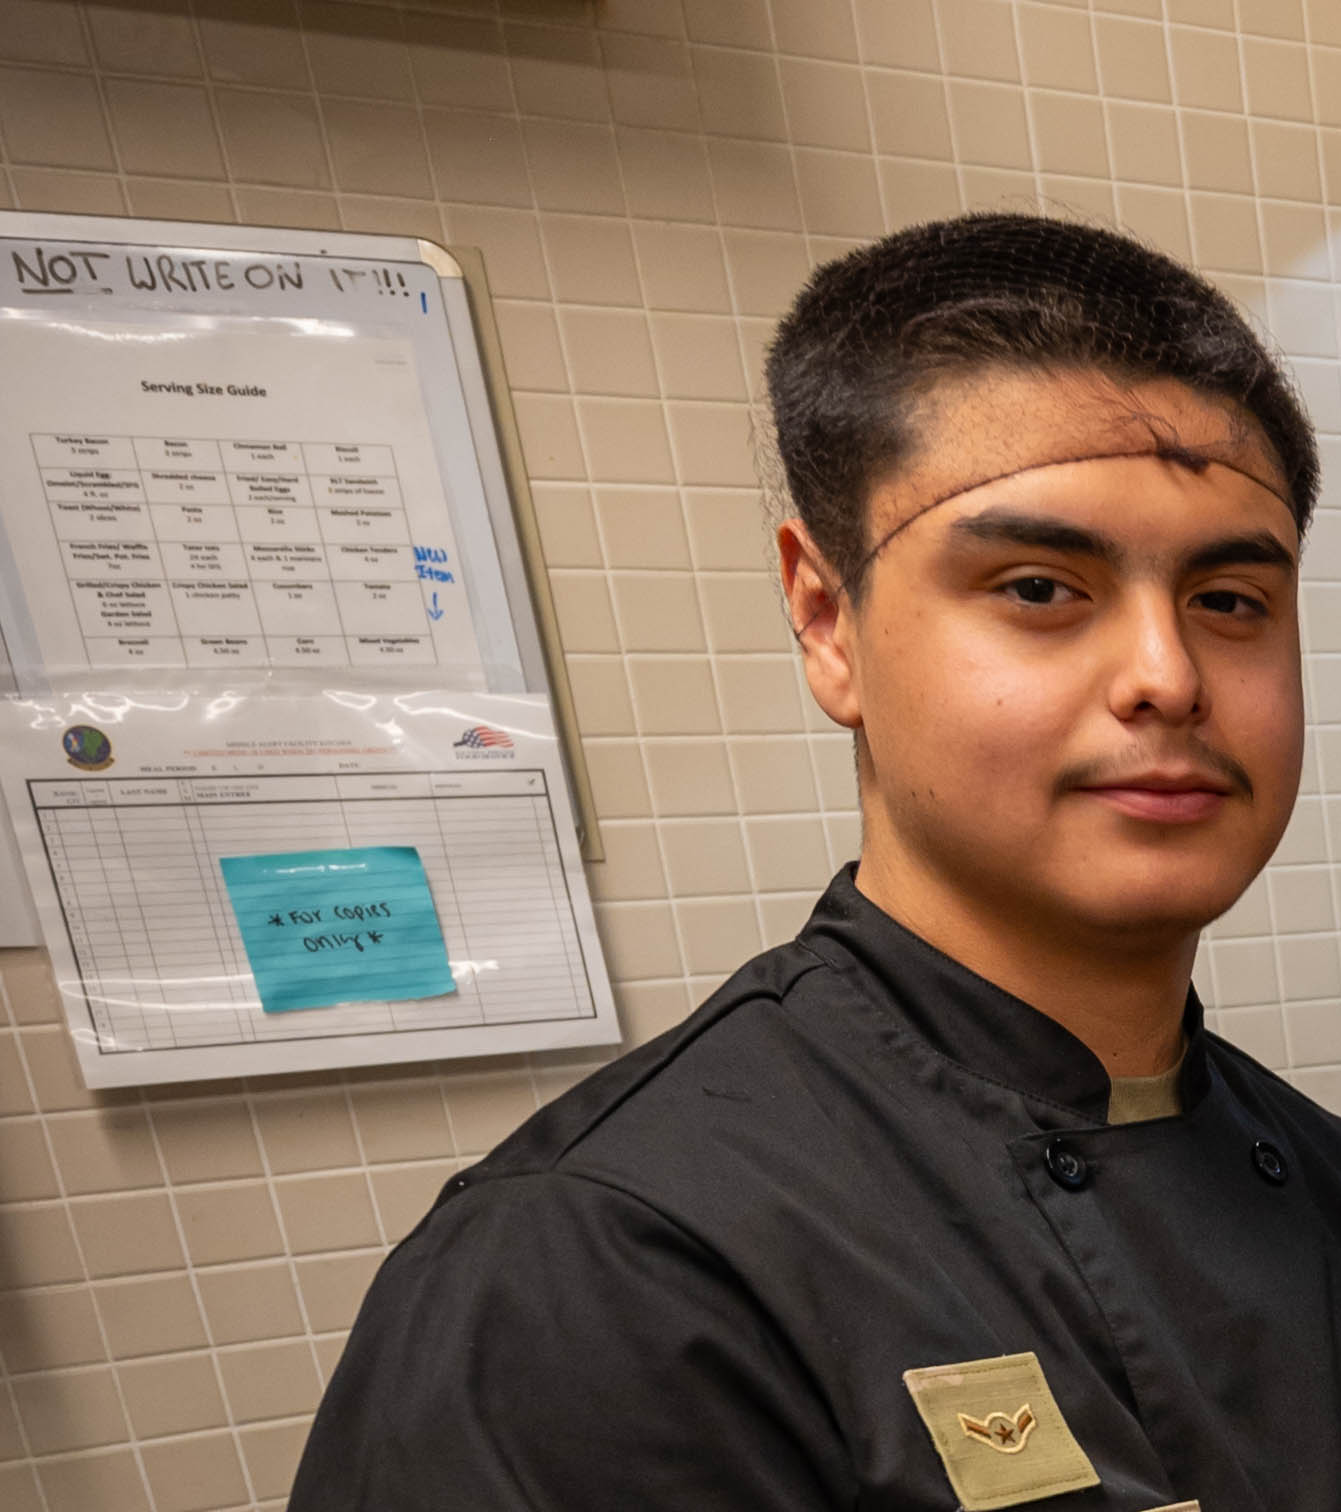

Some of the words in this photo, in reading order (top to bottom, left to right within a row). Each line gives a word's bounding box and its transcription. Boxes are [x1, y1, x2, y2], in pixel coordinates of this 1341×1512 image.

[12, 247, 111, 288] NOT
[125, 254, 235, 293] WRITE
[244, 262, 304, 291] ON
[141, 379, 194, 397] Serving
[196, 382, 224, 396] Size
[226, 383, 268, 398] Guide
